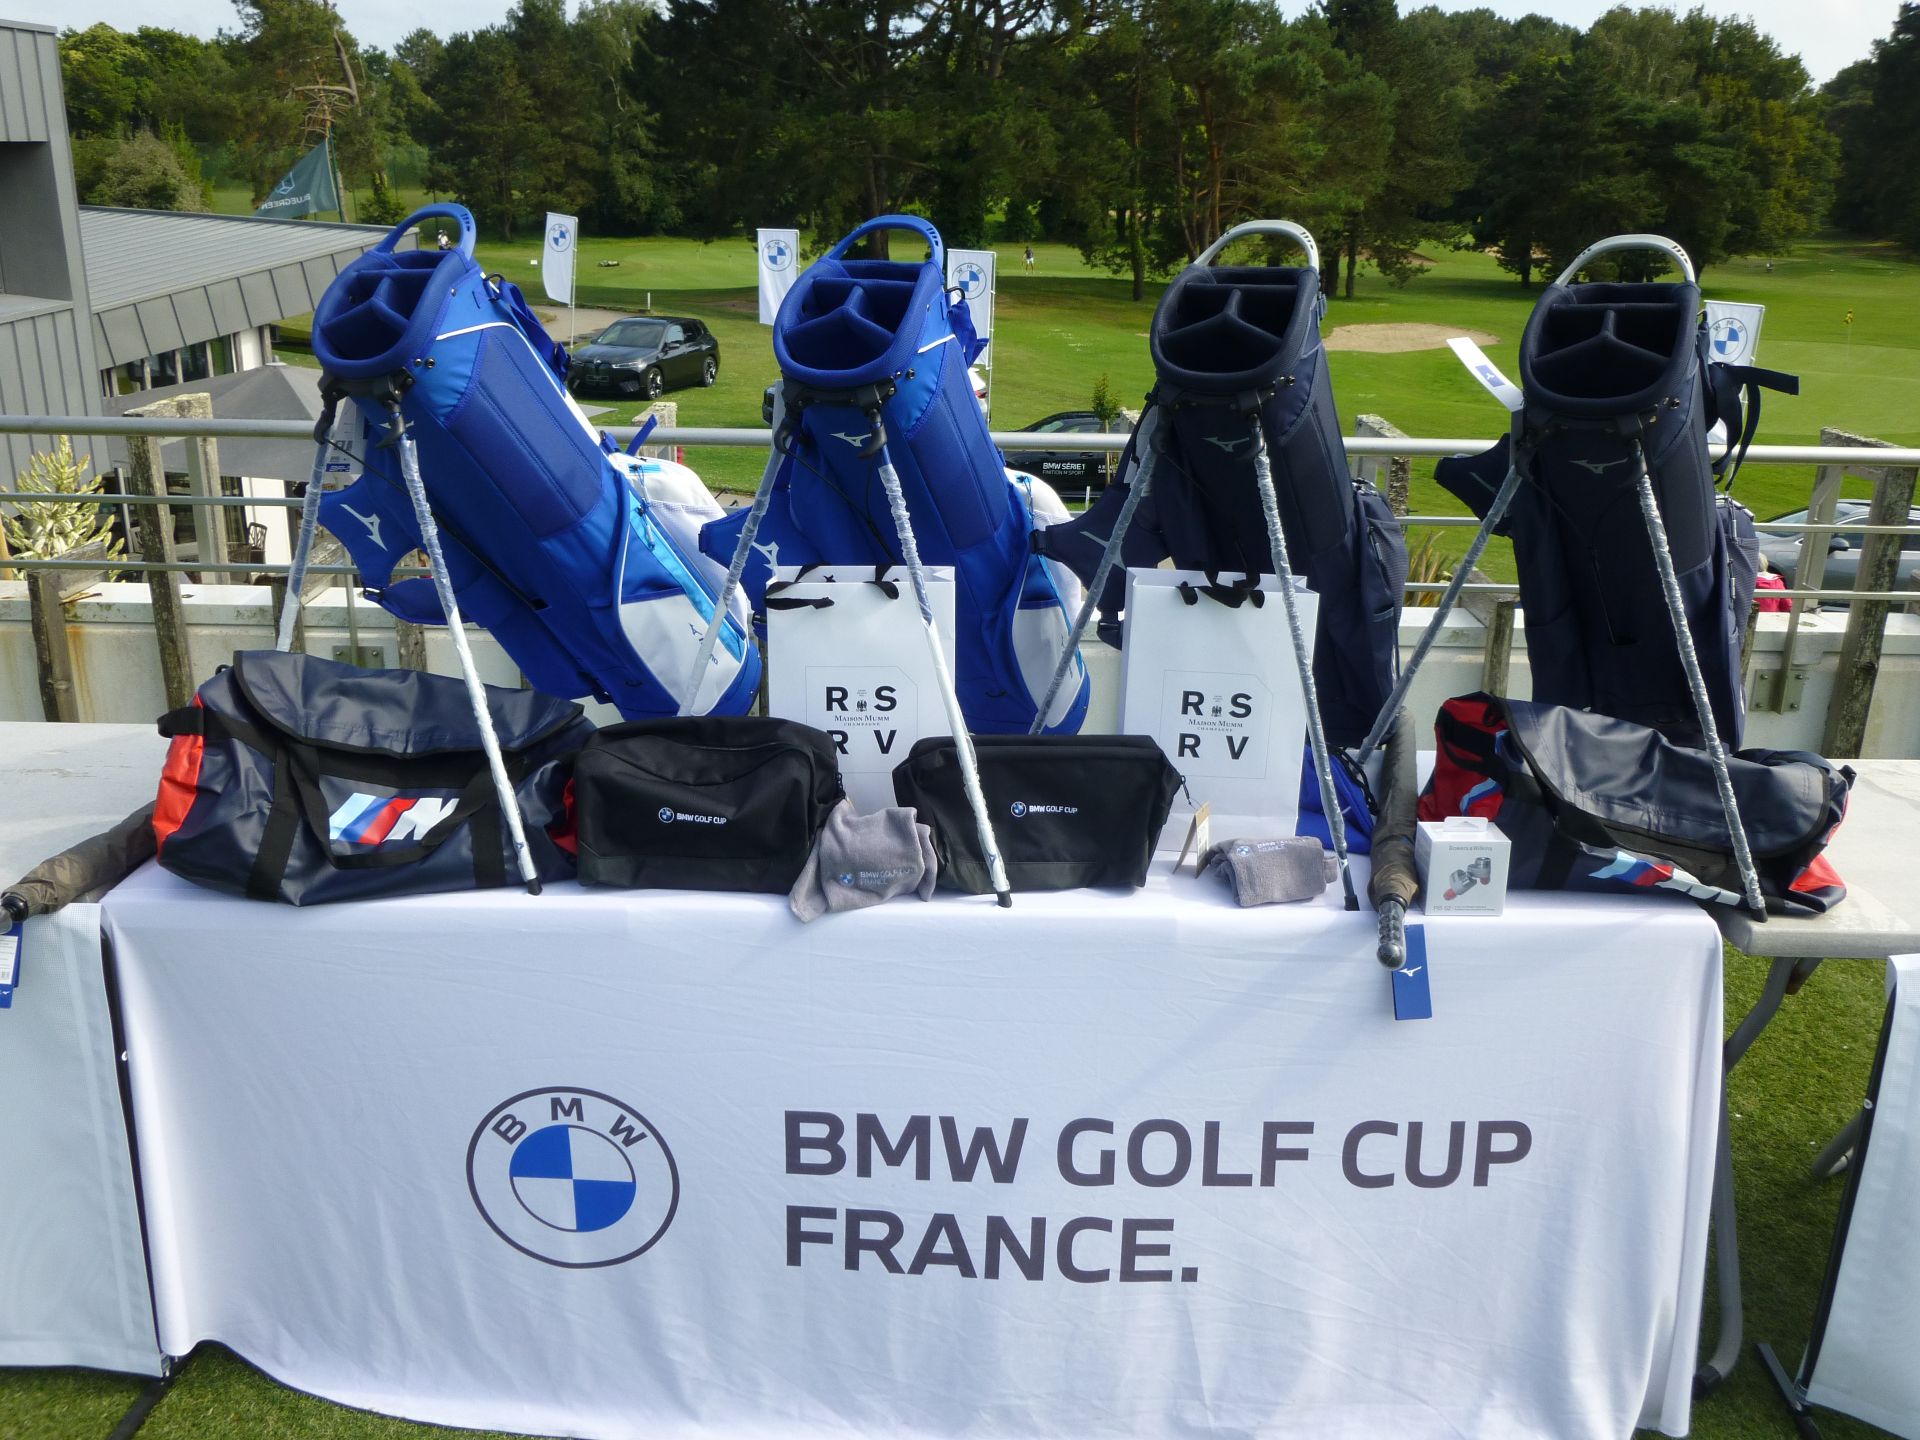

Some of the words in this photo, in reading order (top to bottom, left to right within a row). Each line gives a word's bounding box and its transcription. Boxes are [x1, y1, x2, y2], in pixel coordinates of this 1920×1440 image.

[676, 813, 694, 821] BMW
[694, 814, 713, 824] GOLF
[713, 816, 727, 825] CUP
[1029, 805, 1045, 813] BMW
[1045, 805, 1063, 813] GOLF
[1064, 806, 1078, 814] CUP
[860, 871, 880, 879] BMW
[491, 1096, 648, 1148] BMW
[785, 1110, 1029, 1184] BMW
[1057, 1117, 1315, 1188] GOLF
[1341, 1119, 1533, 1189] CUP
[786, 1204, 1199, 1283] FRANCE.
